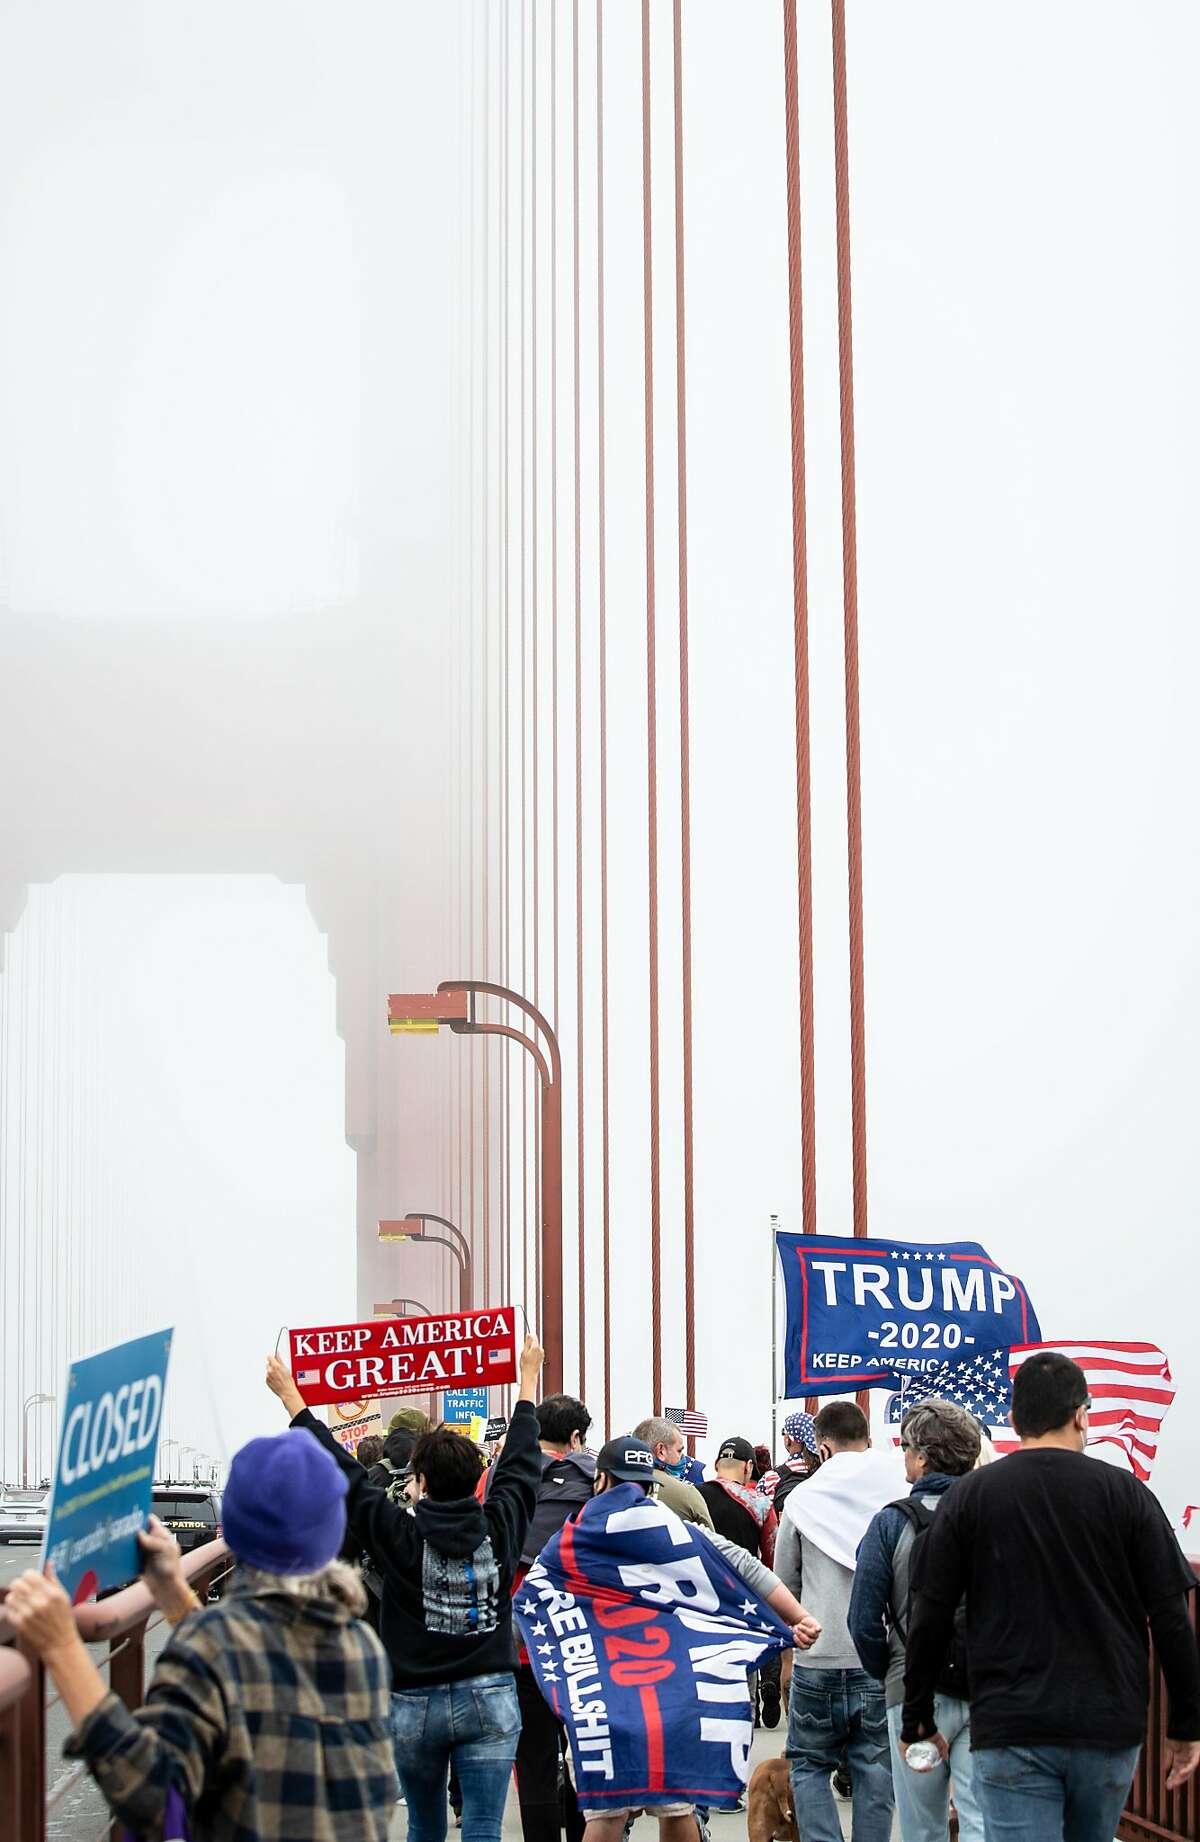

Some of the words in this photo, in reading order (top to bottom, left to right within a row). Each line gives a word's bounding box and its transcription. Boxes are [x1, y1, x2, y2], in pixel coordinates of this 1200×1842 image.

[811, 1261, 1016, 1314] TRUMP
[294, 1329, 372, 1357] KEEP
[380, 1314, 510, 1349] AMERICA
[868, 1321, 975, 1349] -2020-
[324, 1345, 484, 1390] GREAT!
[812, 1353, 863, 1368] KEEP
[446, 1389, 469, 1397] CALL
[472, 1387, 485, 1396] 511
[448, 1400, 484, 1408] TRAFFIC
[455, 1411, 476, 1419] INFO
[60, 1374, 162, 1486] CLOSED
[340, 1424, 369, 1441] STOP
[560, 1634, 614, 1780] BULLSHIT
